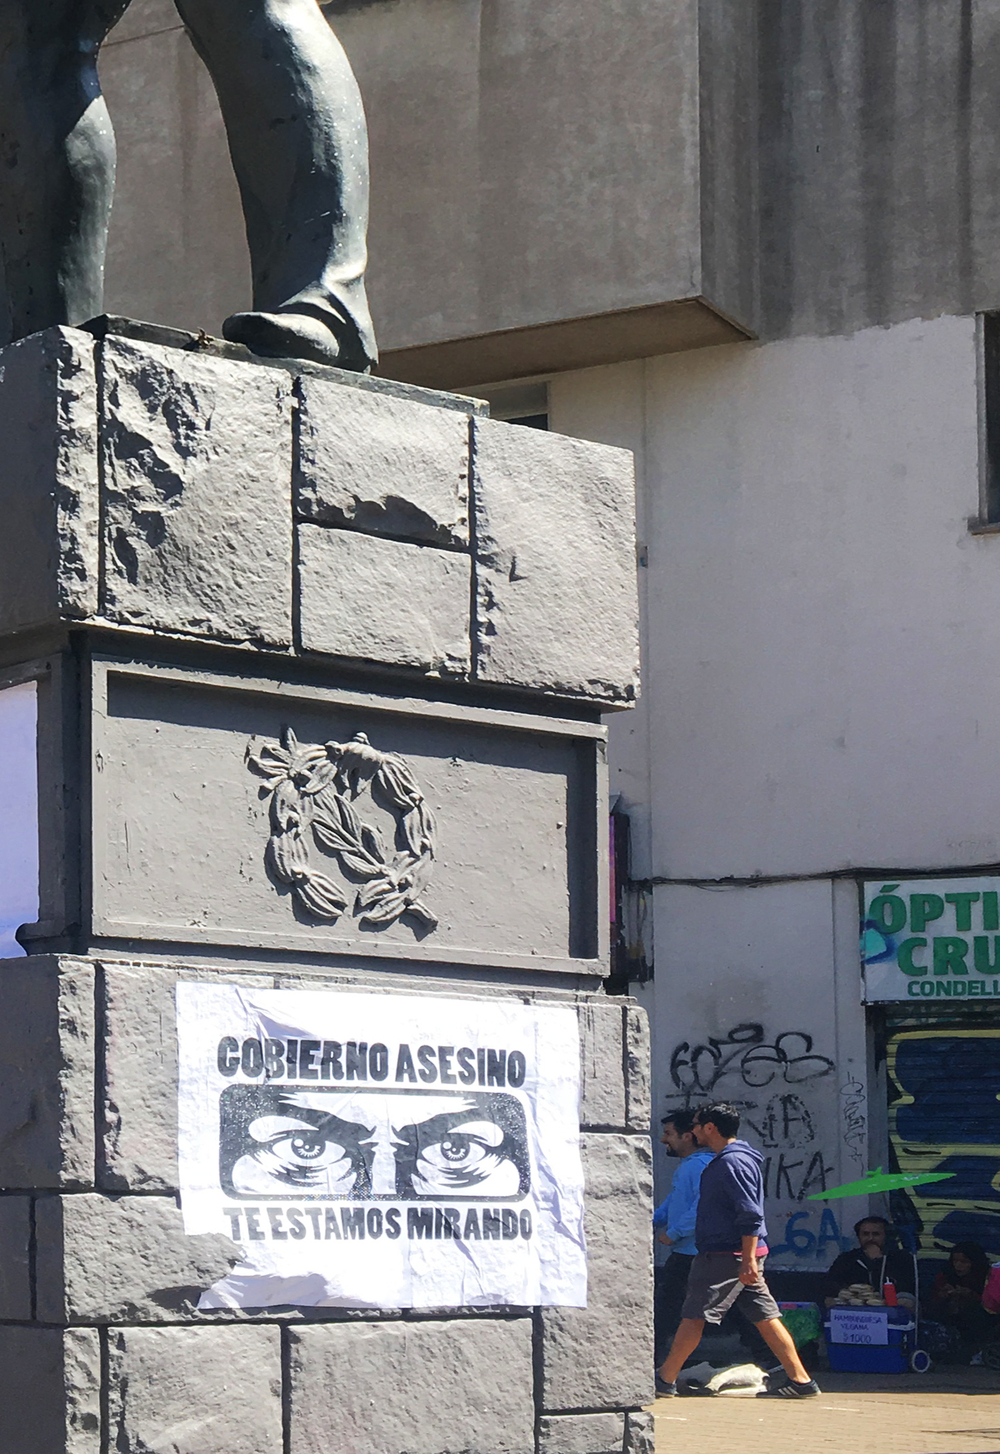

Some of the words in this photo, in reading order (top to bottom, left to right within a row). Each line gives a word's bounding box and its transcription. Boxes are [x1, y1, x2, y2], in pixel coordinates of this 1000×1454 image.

[217, 1036, 389, 1081] GOBIERNO
[395, 1043, 527, 1088] ASESINO
[222, 1207, 265, 1241] TE
[266, 1207, 402, 1241] ESTAMOS
[407, 1207, 533, 1241] MIRANDO
